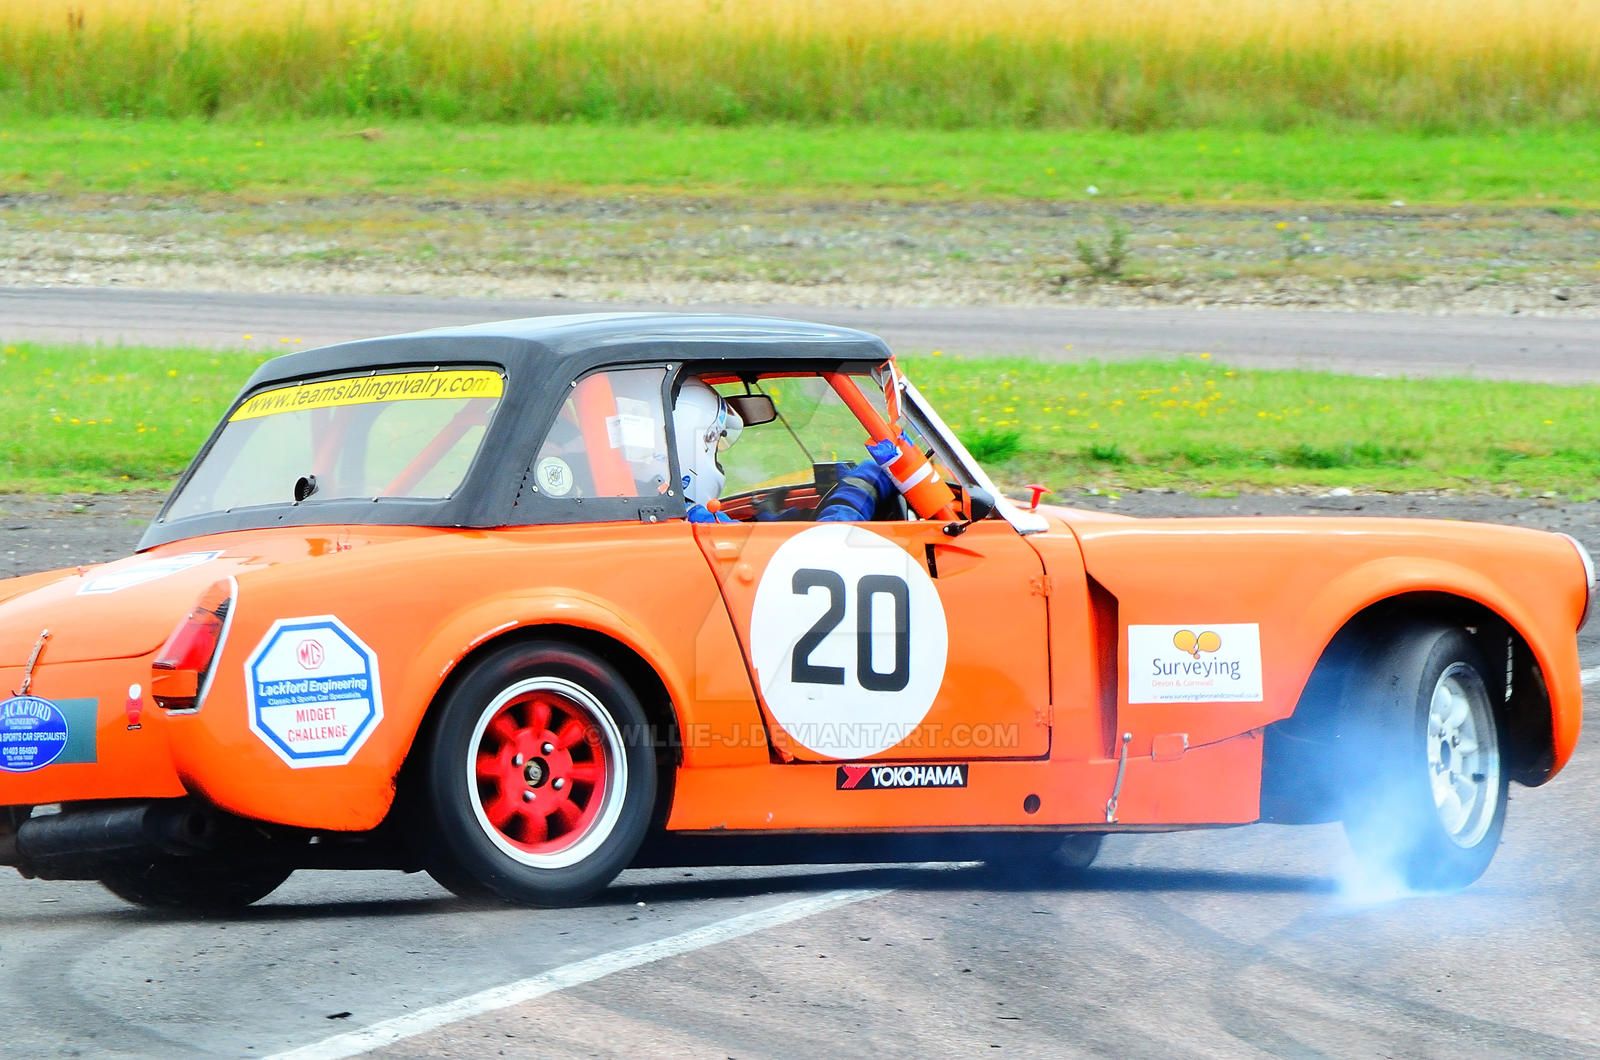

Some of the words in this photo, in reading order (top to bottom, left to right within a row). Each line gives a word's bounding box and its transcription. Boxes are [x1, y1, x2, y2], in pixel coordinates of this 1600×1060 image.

[247, 373, 489, 413] www.teamsiblingrivalry.com
[791, 568, 910, 692] 20
[299, 641, 322, 667] MG
[1152, 656, 1241, 680] Surveying
[259, 680, 308, 697] Lackford
[309, 677, 368, 694] Engineering
[297, 695, 317, 704] Sports
[296, 707, 337, 723] MIDGET
[2, 732, 22, 742] SPORTS
[22, 732, 33, 742] CAR
[33, 731, 66, 741] SPECIALISTS
[288, 725, 348, 742] CHALLENGE
[871, 766, 963, 786] YOKOHAMA
